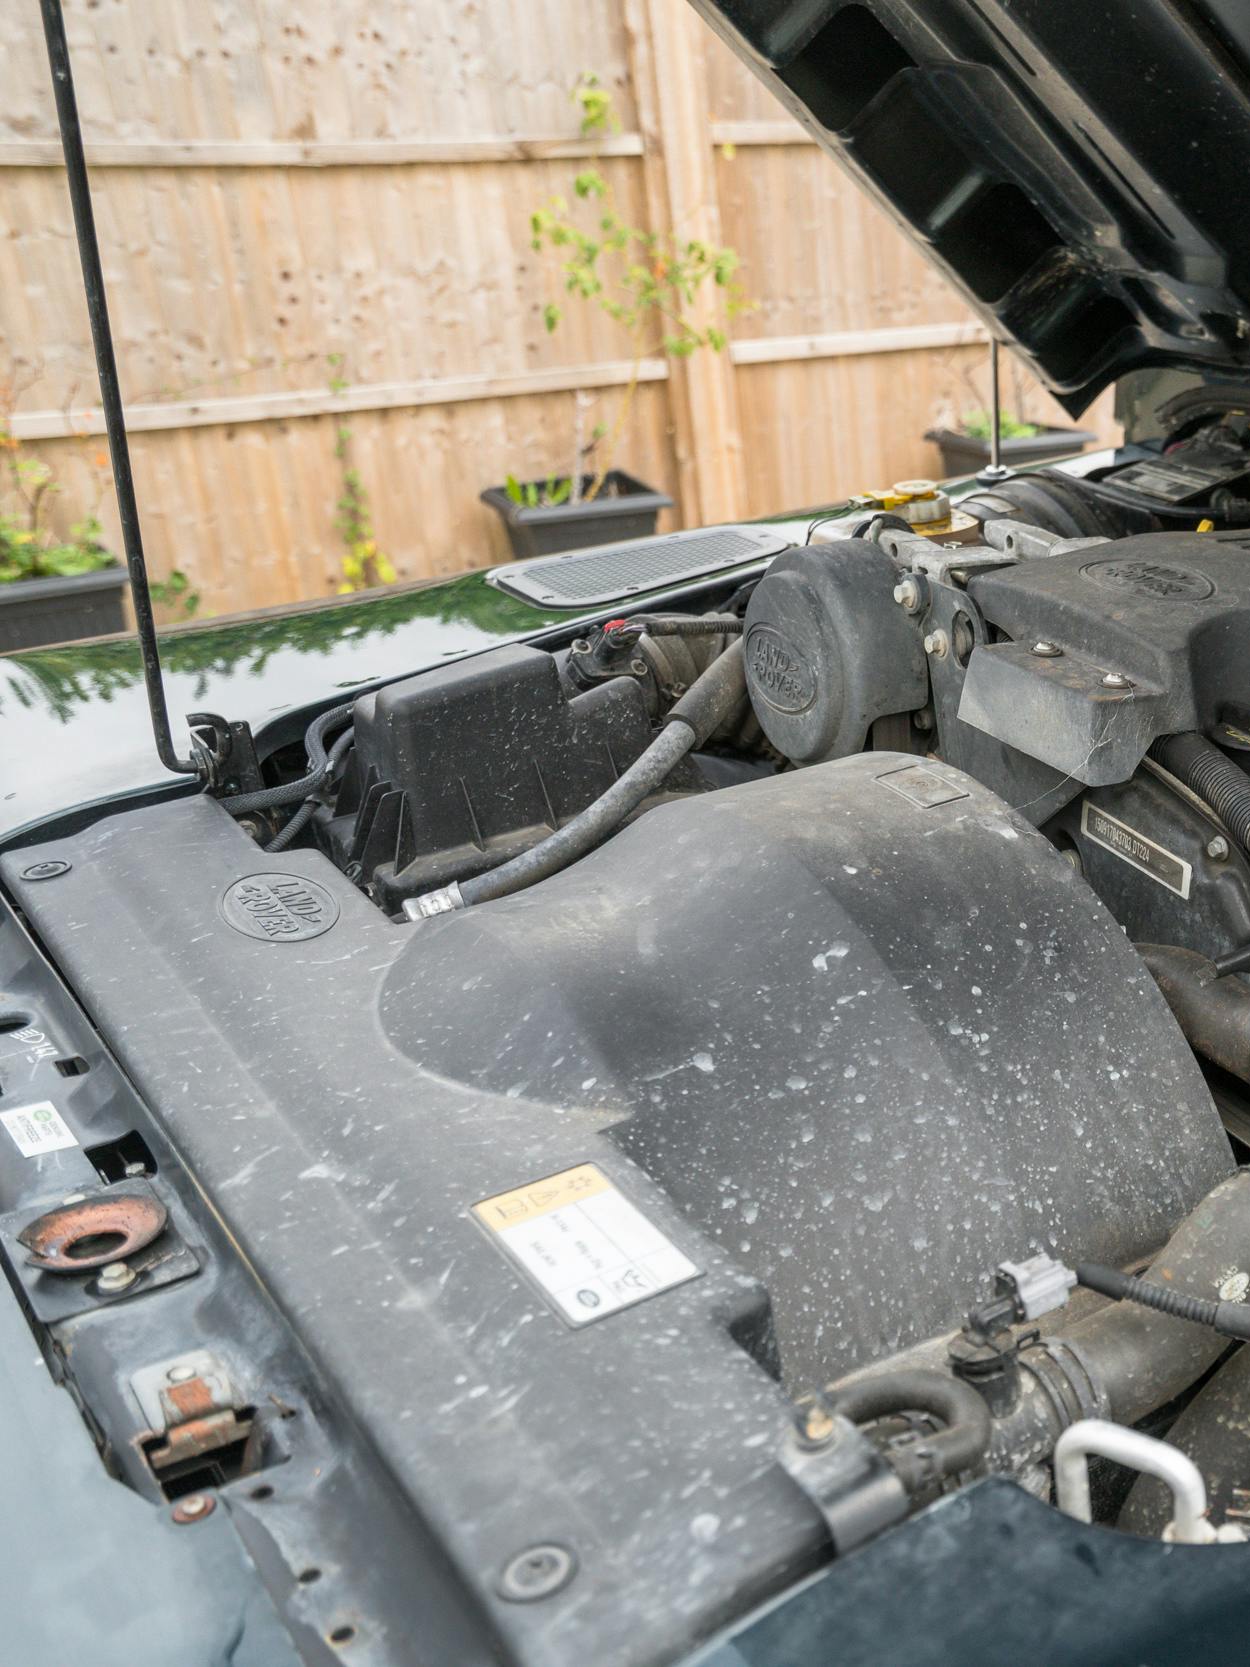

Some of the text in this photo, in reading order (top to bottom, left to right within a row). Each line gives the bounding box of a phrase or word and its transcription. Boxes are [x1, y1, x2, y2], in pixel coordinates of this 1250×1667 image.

[755, 637, 793, 673] LAND
[754, 663, 804, 699] ROVER
[239, 887, 300, 936] ROVER
[267, 882, 322, 917] LAND
